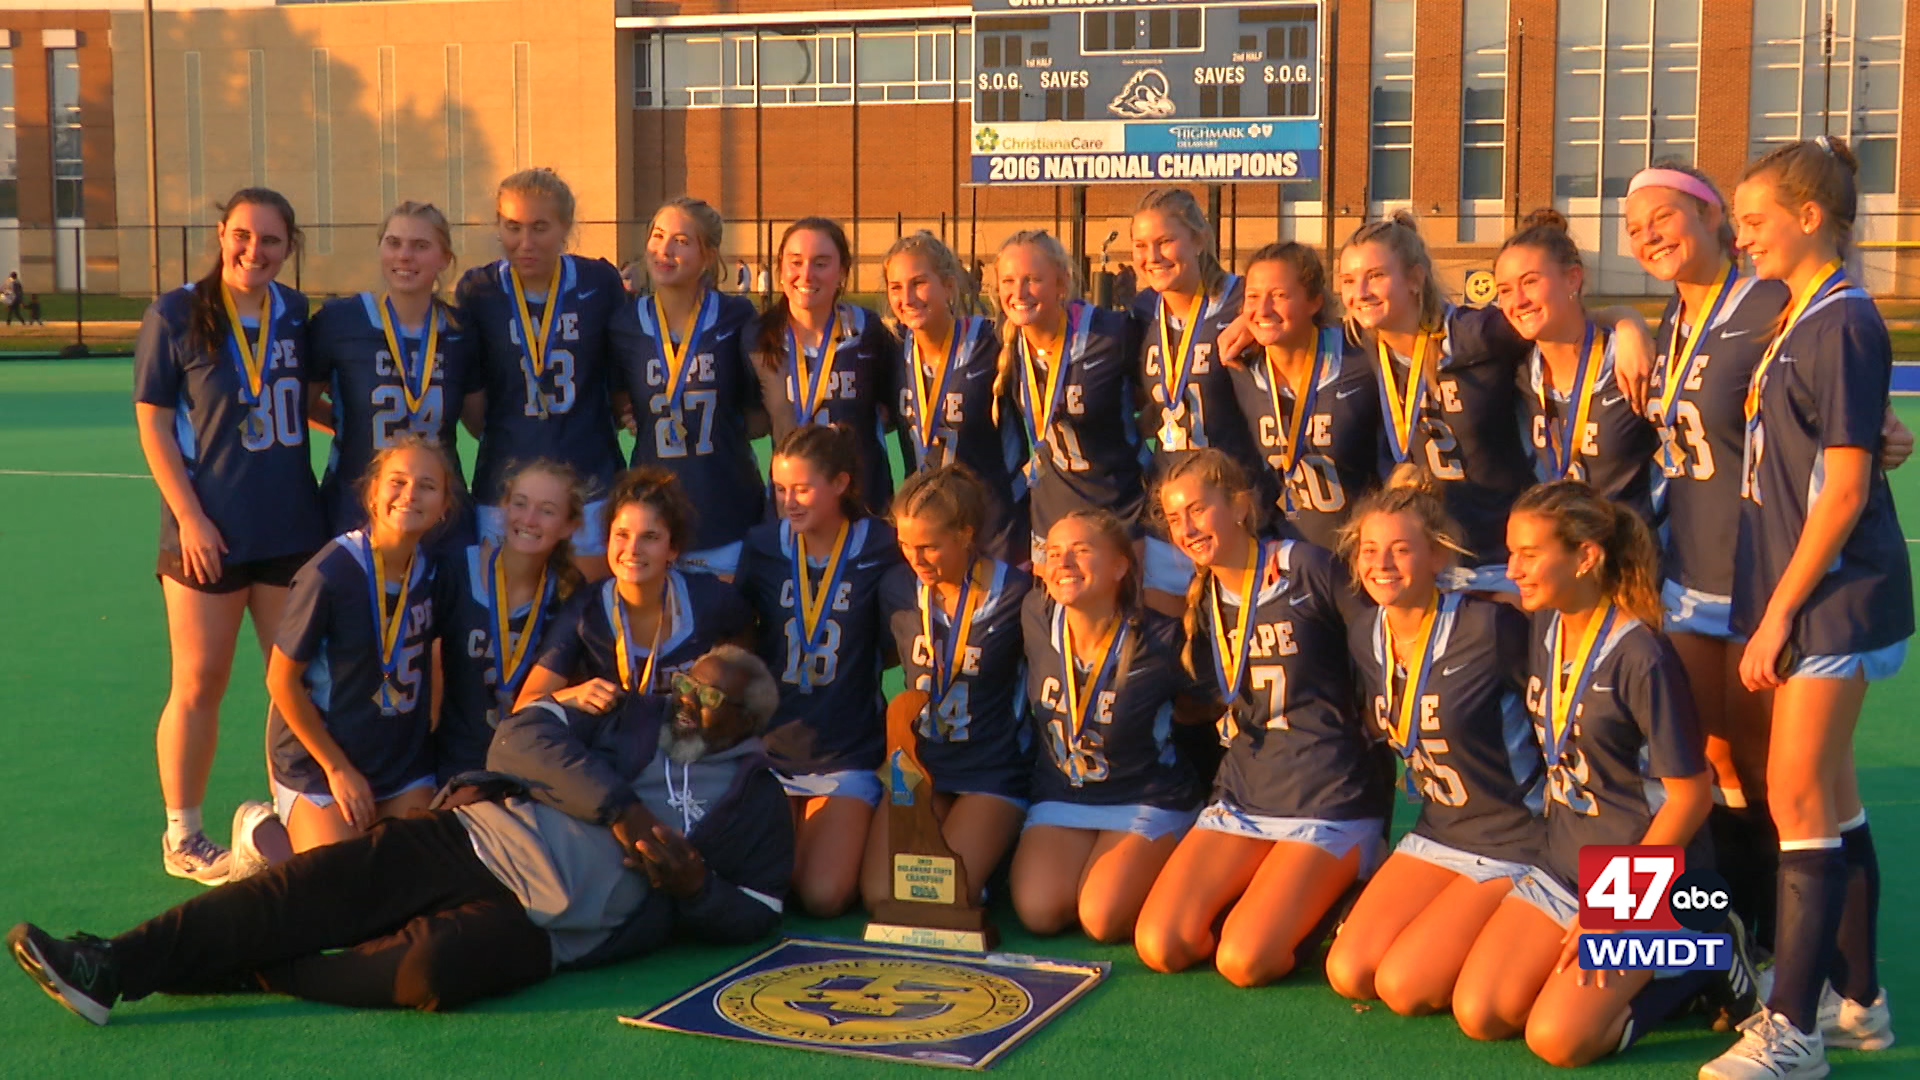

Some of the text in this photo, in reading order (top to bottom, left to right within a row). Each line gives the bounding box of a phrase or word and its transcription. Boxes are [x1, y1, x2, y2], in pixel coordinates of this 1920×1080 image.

[1036, 58, 1052, 66] HALF
[1245, 52, 1262, 61] HALF
[978, 72, 1023, 90] S.O.G.
[1040, 70, 1089, 88] SAVES
[1194, 66, 1245, 84] SAVES
[1263, 65, 1312, 83] S.O.G.
[1002, 137, 1103, 150] ChristianaCare
[989, 151, 1298, 180] 2016 NATIONAL CHAMPIONS
[509, 313, 579, 345] CE
[238, 339, 298, 370] PE
[375, 350, 444, 380] CE
[646, 353, 715, 386] CE
[1146, 343, 1212, 376] CE
[520, 349, 576, 416] 13
[786, 371, 856, 402] PE
[1650, 354, 1710, 391] CE
[900, 388, 964, 423] CE
[649, 389, 717, 458] 27
[1259, 413, 1332, 447] CE
[1533, 414, 1599, 456] CE
[780, 579, 852, 612] CE
[912, 634, 983, 676] CE
[1041, 676, 1117, 724] CE
[1250, 665, 1290, 730] 7
[1374, 694, 1440, 730] CE
